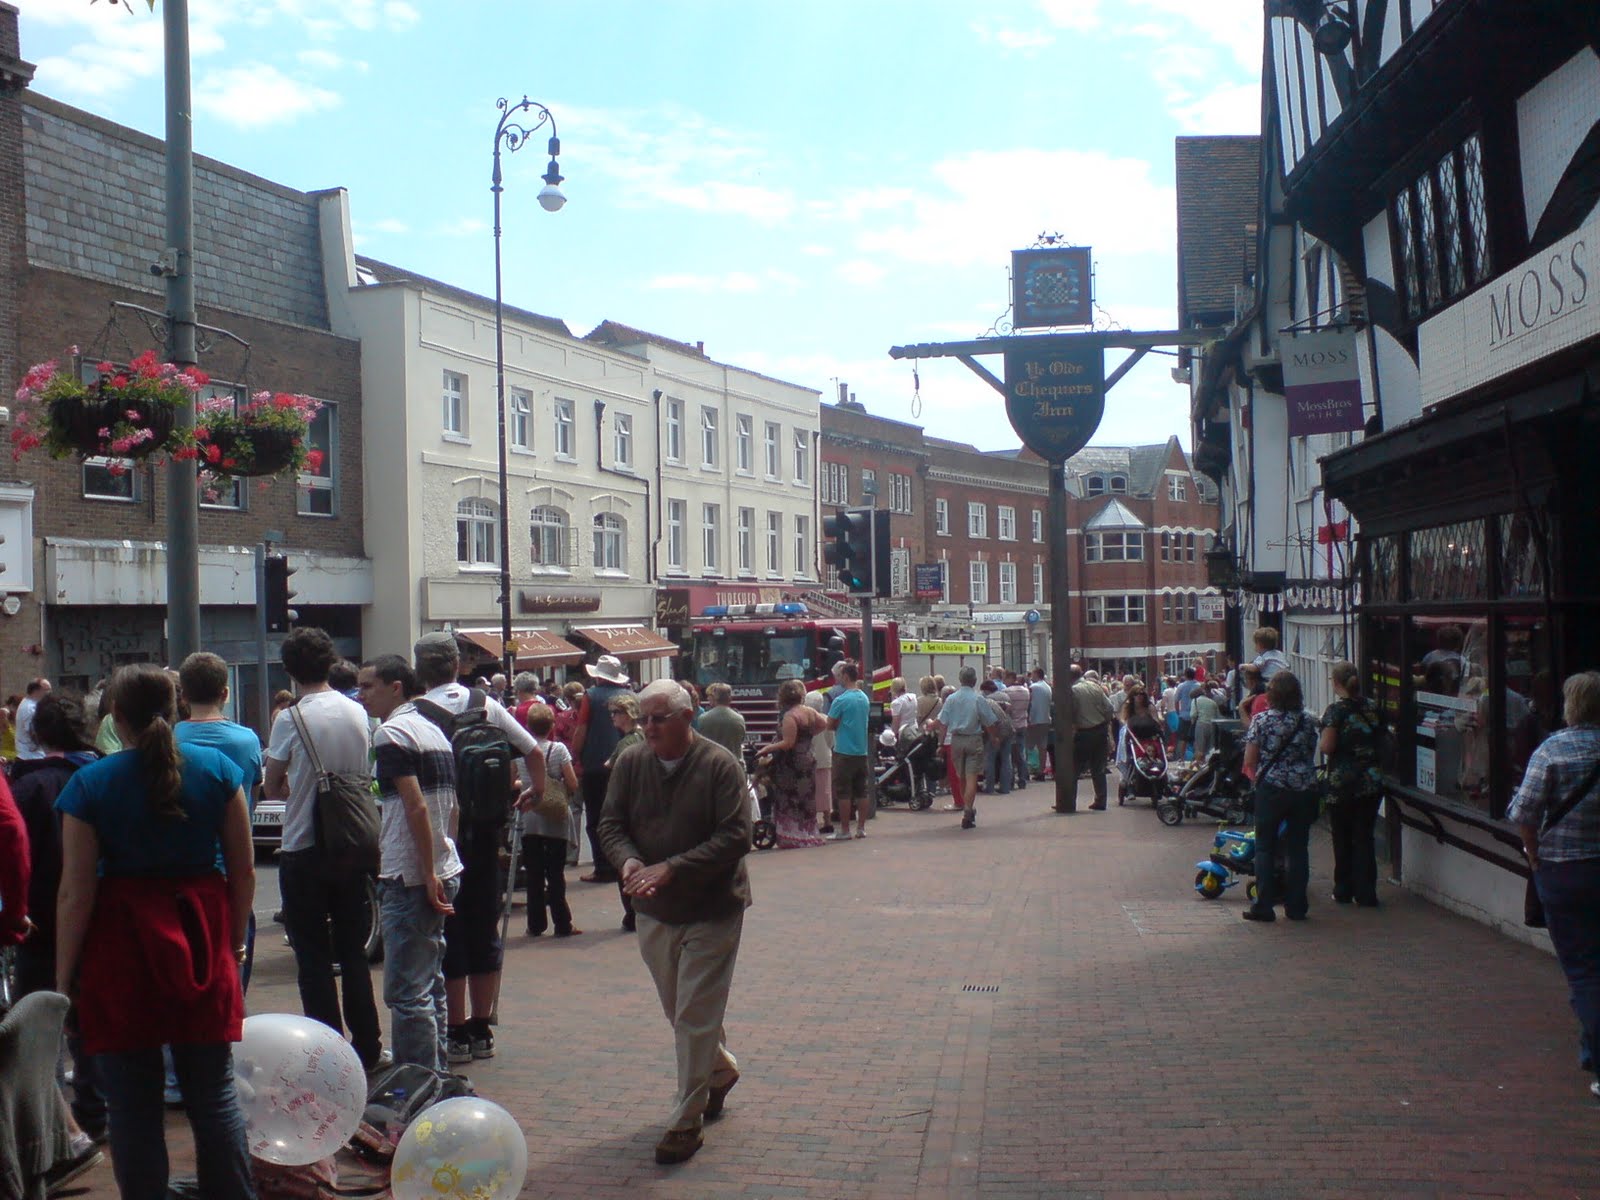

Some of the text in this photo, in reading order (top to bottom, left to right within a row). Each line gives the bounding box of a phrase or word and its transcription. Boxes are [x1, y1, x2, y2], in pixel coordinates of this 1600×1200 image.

[1489, 240, 1588, 347] MOSS
[1294, 349, 1348, 367] MOSS
[1024, 360, 1084, 379] Ye Olde
[1015, 381, 1094, 400] Chequers
[1033, 401, 1074, 420] Inn
[656, 596, 688, 621] Slug
[263, 813, 281, 823] FRK
